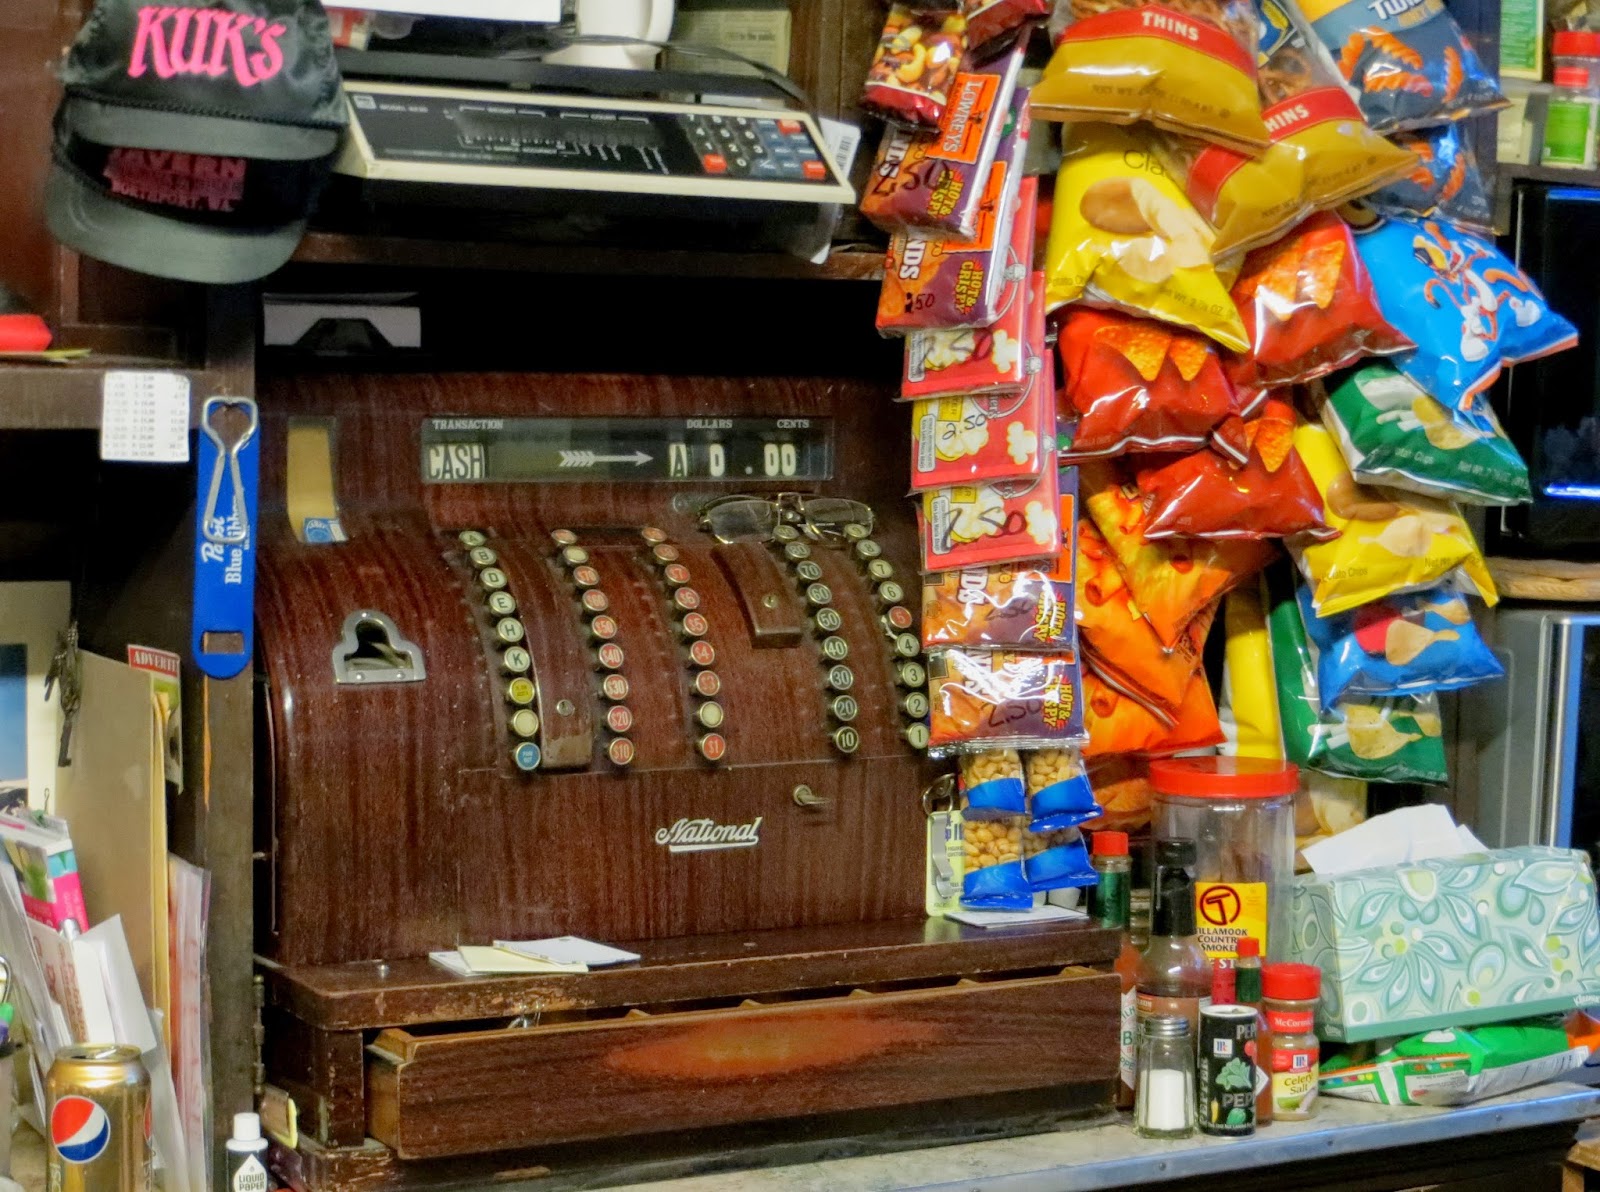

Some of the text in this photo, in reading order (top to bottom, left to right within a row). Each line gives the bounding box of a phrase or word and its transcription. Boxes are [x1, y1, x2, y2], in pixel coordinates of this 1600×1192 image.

[1141, 12, 1199, 41] THINS
[943, 81, 983, 153] LOWREY'S
[1264, 104, 1309, 133] HINS
[953, 260, 974, 314] CRISPY
[432, 419, 504, 430] TRANSACTION
[686, 419, 733, 429] DOLLARS
[776, 419, 810, 429] CENTS
[942, 413, 986, 441] 2.50
[429, 443, 485, 480] CASH
[201, 516, 226, 563] Past
[225, 549, 243, 585] Blue
[802, 565, 819, 577] 70
[488, 572, 499, 583] D
[811, 587, 829, 601] 60
[497, 597, 508, 609] E
[821, 613, 838, 627] 50
[504, 624, 515, 637] H
[828, 642, 845, 656] 40
[904, 638, 914, 653] 4
[134, 649, 179, 673] ADVERTI
[513, 652, 523, 666] K
[833, 670, 850, 685] 30
[909, 668, 918, 683] 3
[607, 679, 626, 695] $30
[837, 700, 854, 716] 20
[912, 698, 922, 714] 2
[1058, 683, 1074, 721] HOT&
[611, 711, 629, 727] $20
[708, 739, 720, 755] $1
[841, 733, 855, 749] 10
[614, 744, 631, 760] $10
[655, 816, 763, 846] National
[1198, 935, 1237, 943] COUNTR
[1201, 943, 1237, 952] SMOKE
[1284, 1073, 1313, 1087] Celery
[1290, 1083, 1308, 1095] Salt
